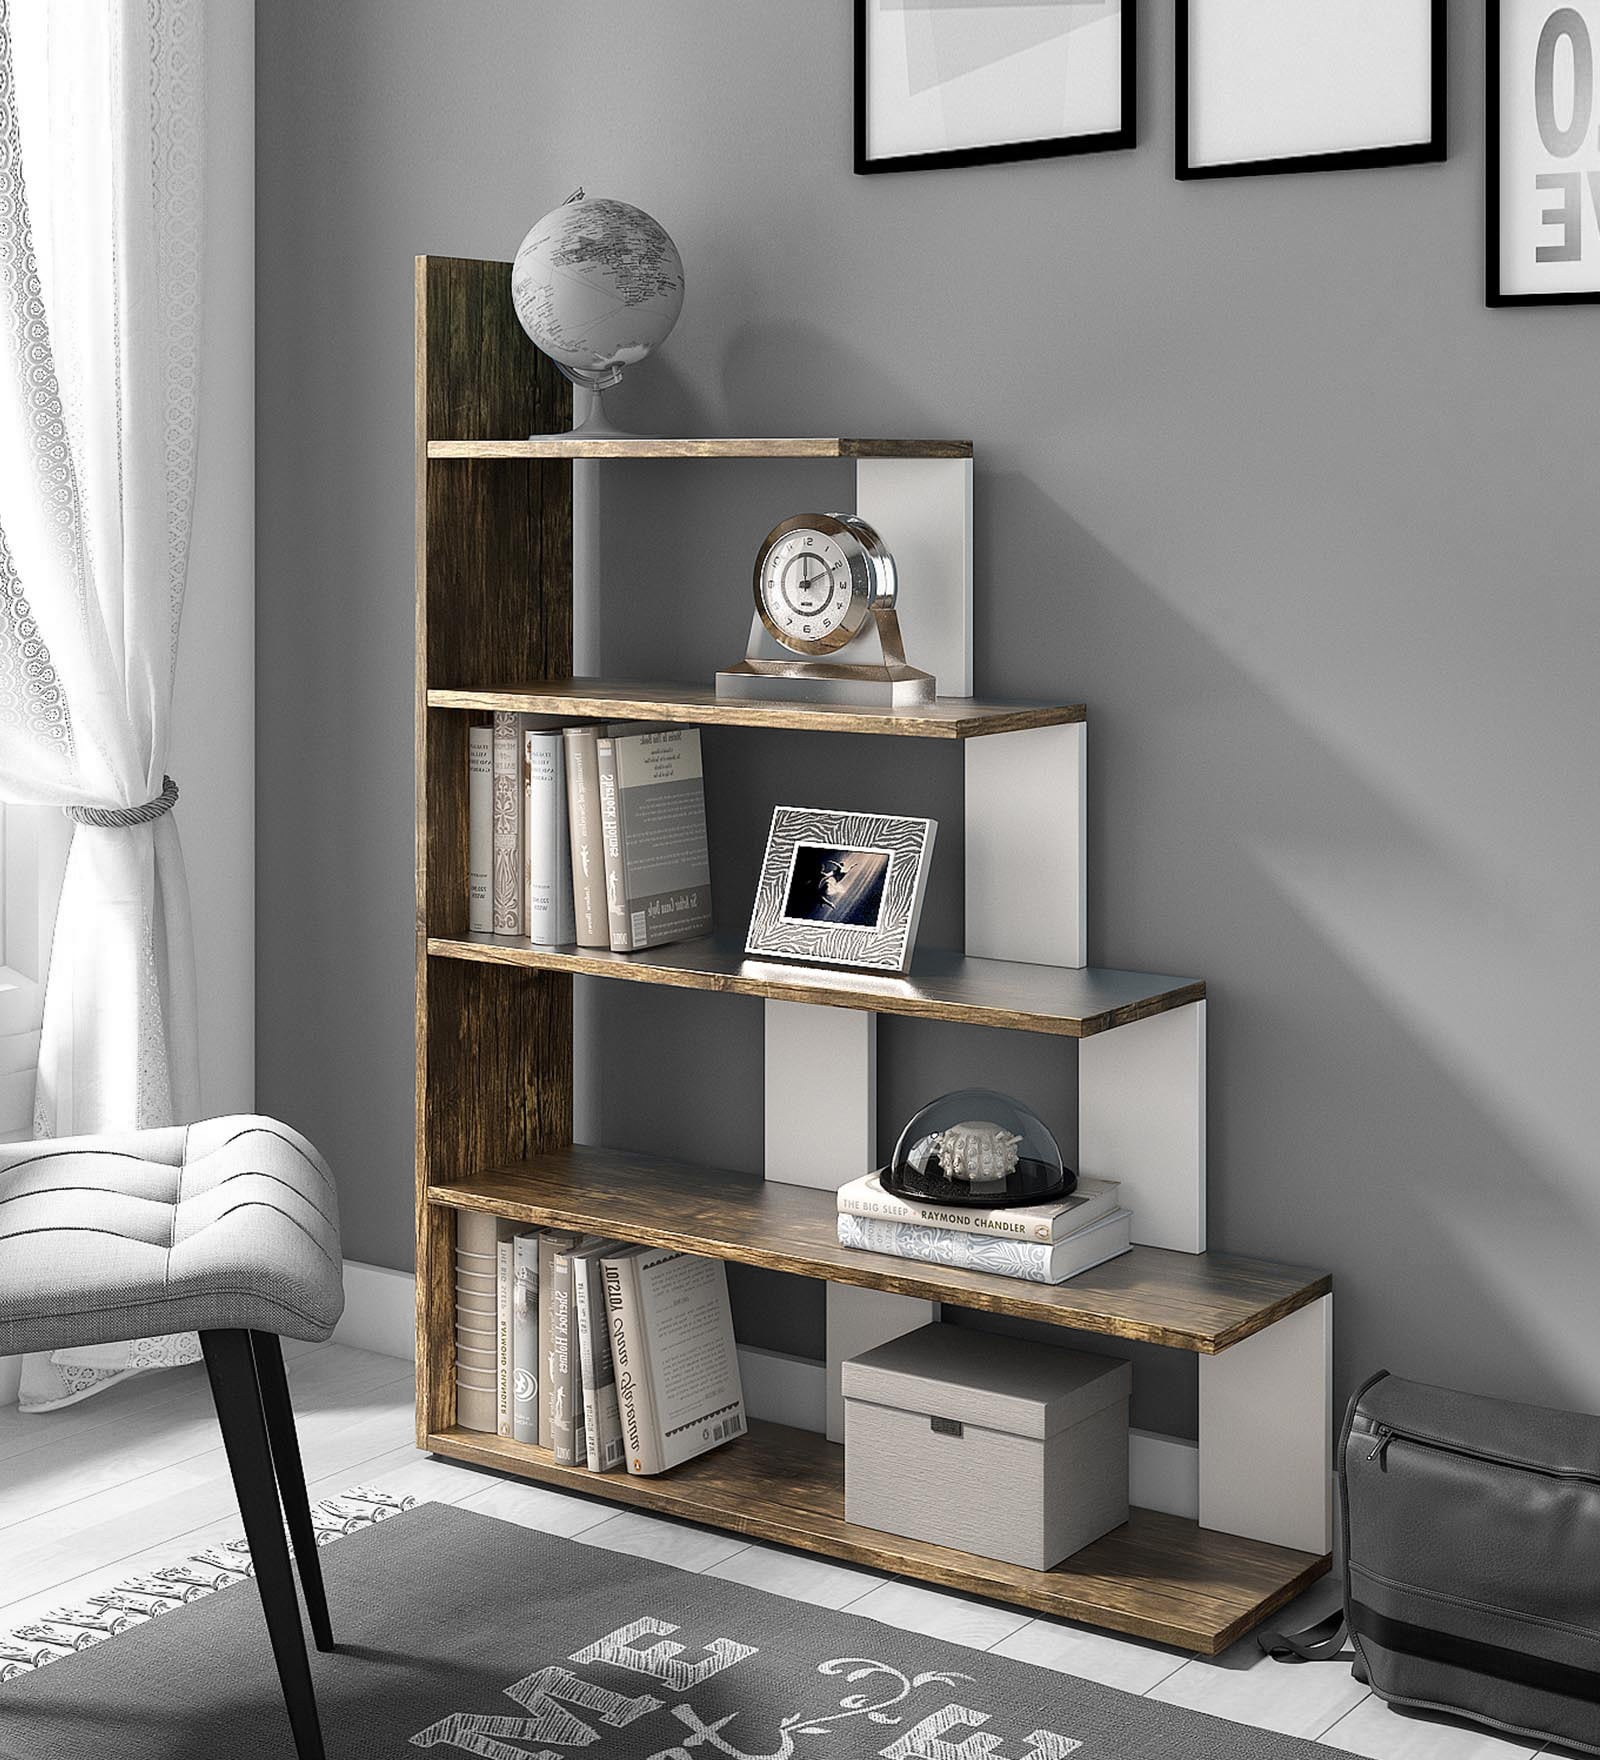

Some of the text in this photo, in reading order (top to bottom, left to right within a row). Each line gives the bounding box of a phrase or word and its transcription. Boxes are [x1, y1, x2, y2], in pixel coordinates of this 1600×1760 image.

[803, 537, 814, 546] 12
[835, 559, 843, 569] 2
[839, 581, 847, 590] 3
[786, 617, 793, 626] 7
[823, 617, 832, 628] 5
[802, 624, 812, 634] 6
[843, 1199, 1026, 1234] THE BIG SLEEP RAYMOND CHANDLER
